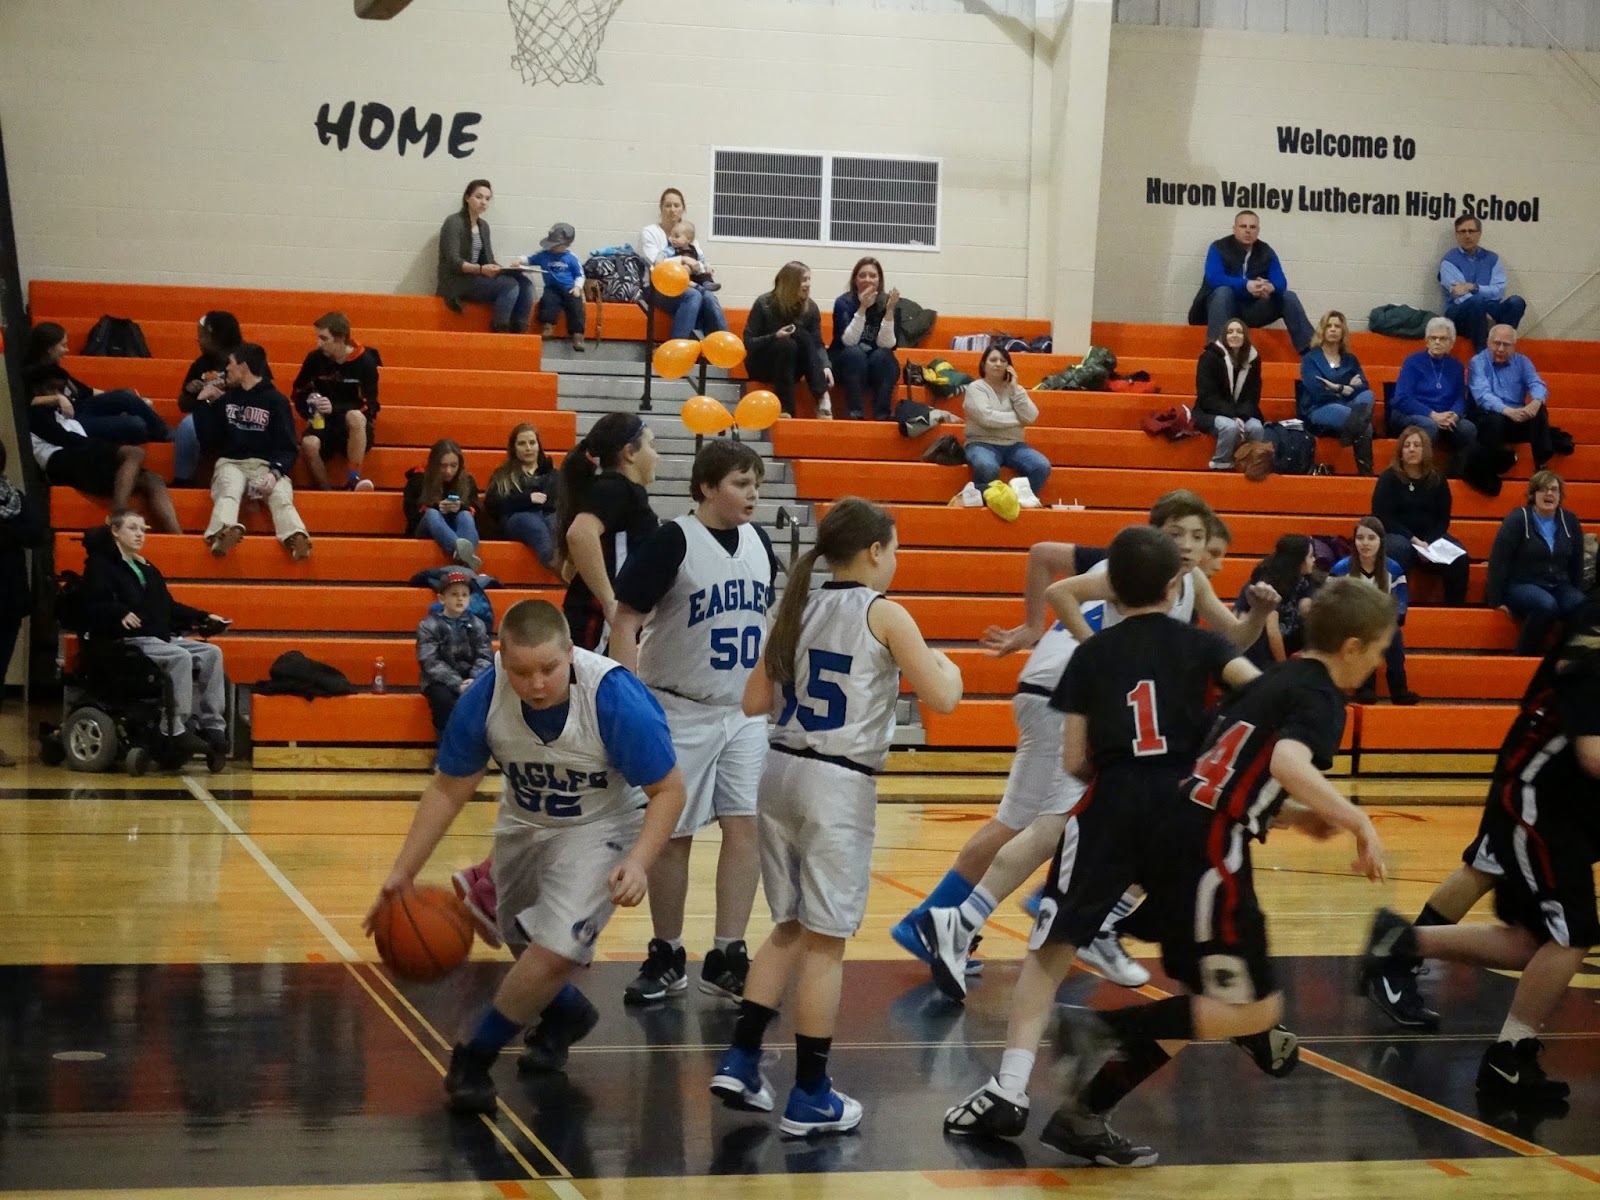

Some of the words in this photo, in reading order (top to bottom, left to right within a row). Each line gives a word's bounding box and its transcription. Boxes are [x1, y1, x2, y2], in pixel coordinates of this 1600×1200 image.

[314, 100, 482, 159] HOME
[1276, 126, 1388, 159] Welcome
[1393, 135, 1416, 161] to
[1146, 177, 1216, 207] Huron
[1221, 180, 1293, 213] Valley
[1298, 185, 1400, 215] Lutheran
[1406, 190, 1456, 220] High
[1462, 193, 1540, 222] School
[710, 625, 762, 670] 50
[1126, 679, 1168, 757] 1
[1179, 714, 1256, 811] 4
